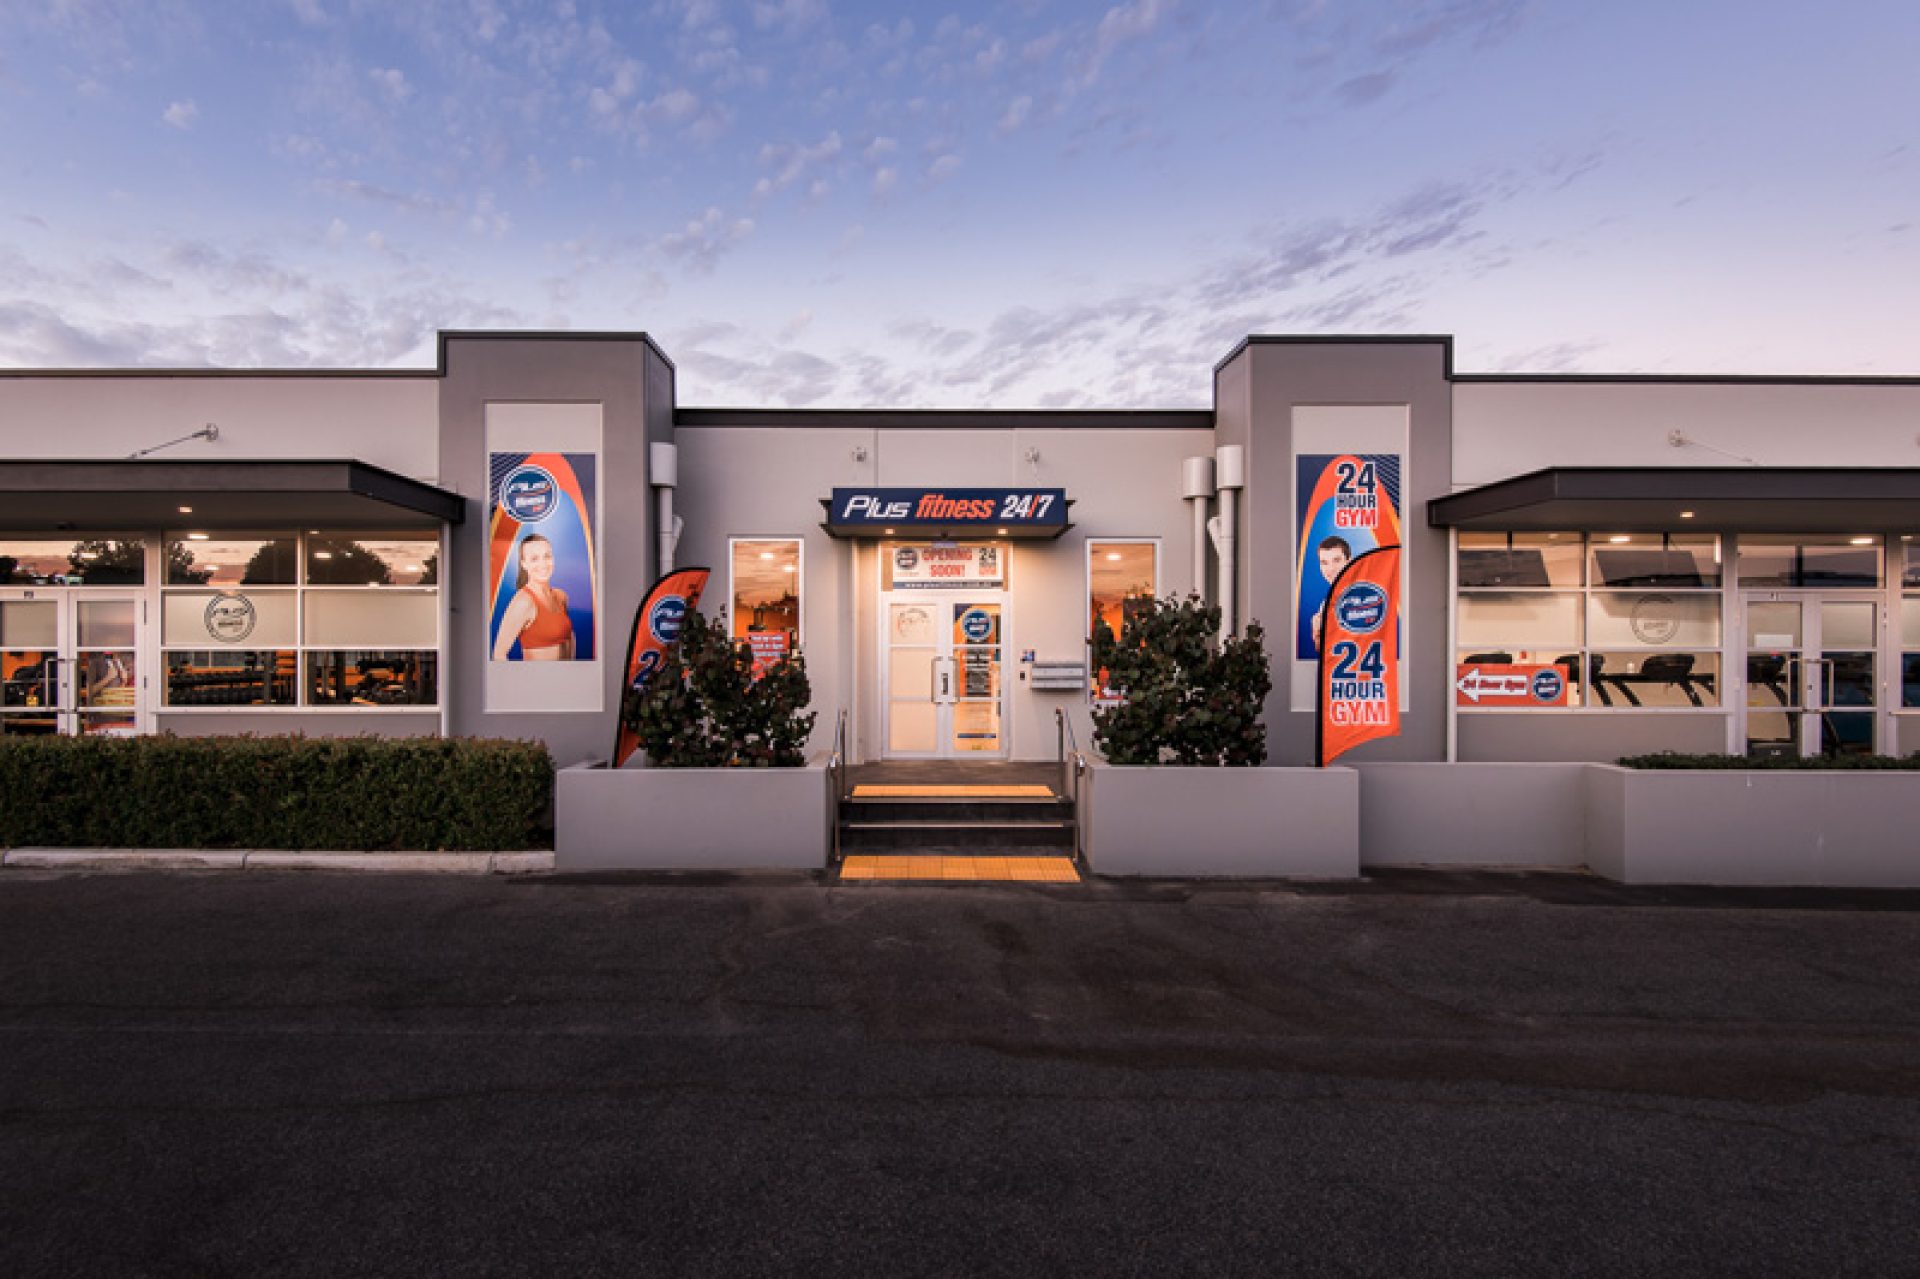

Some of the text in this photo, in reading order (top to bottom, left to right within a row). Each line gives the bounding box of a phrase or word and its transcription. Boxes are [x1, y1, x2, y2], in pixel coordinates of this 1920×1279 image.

[1336, 462, 1376, 493] 24
[842, 493, 1055, 519] Plus fitness 24/7
[1336, 494, 1376, 508] HOUR
[1336, 509, 1376, 527] GYM
[922, 547, 973, 561] OPENING
[1332, 641, 1386, 678] 24
[1331, 681, 1385, 700] HOUR
[1331, 701, 1389, 724] GYM
